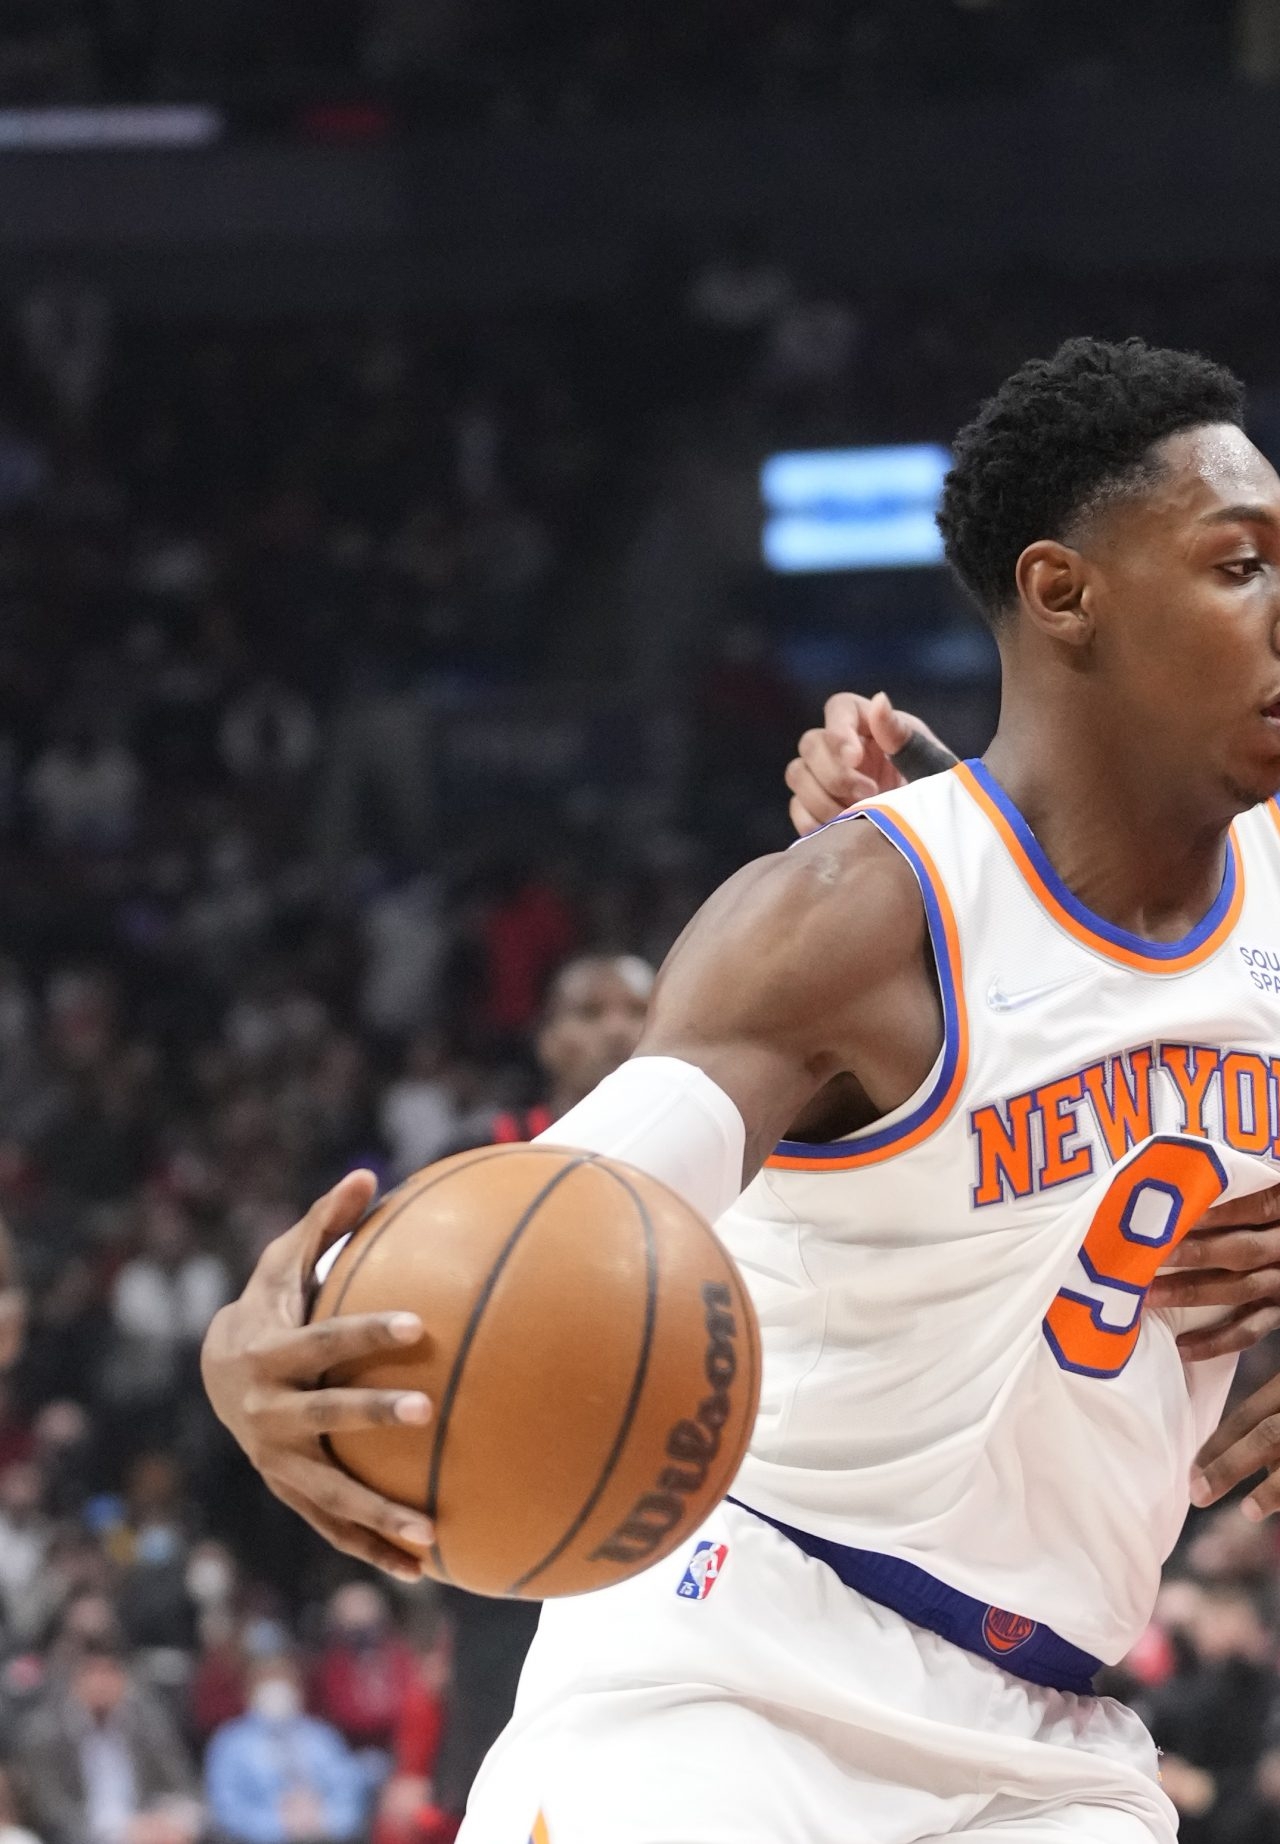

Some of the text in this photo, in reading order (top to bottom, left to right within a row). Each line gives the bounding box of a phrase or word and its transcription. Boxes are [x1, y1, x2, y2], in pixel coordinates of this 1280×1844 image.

[969, 1044, 1154, 1209] NEW
[1042, 1136, 1229, 1380] 9
[586, 1281, 737, 1563] Wilson
[679, 1581, 697, 1596] 75
